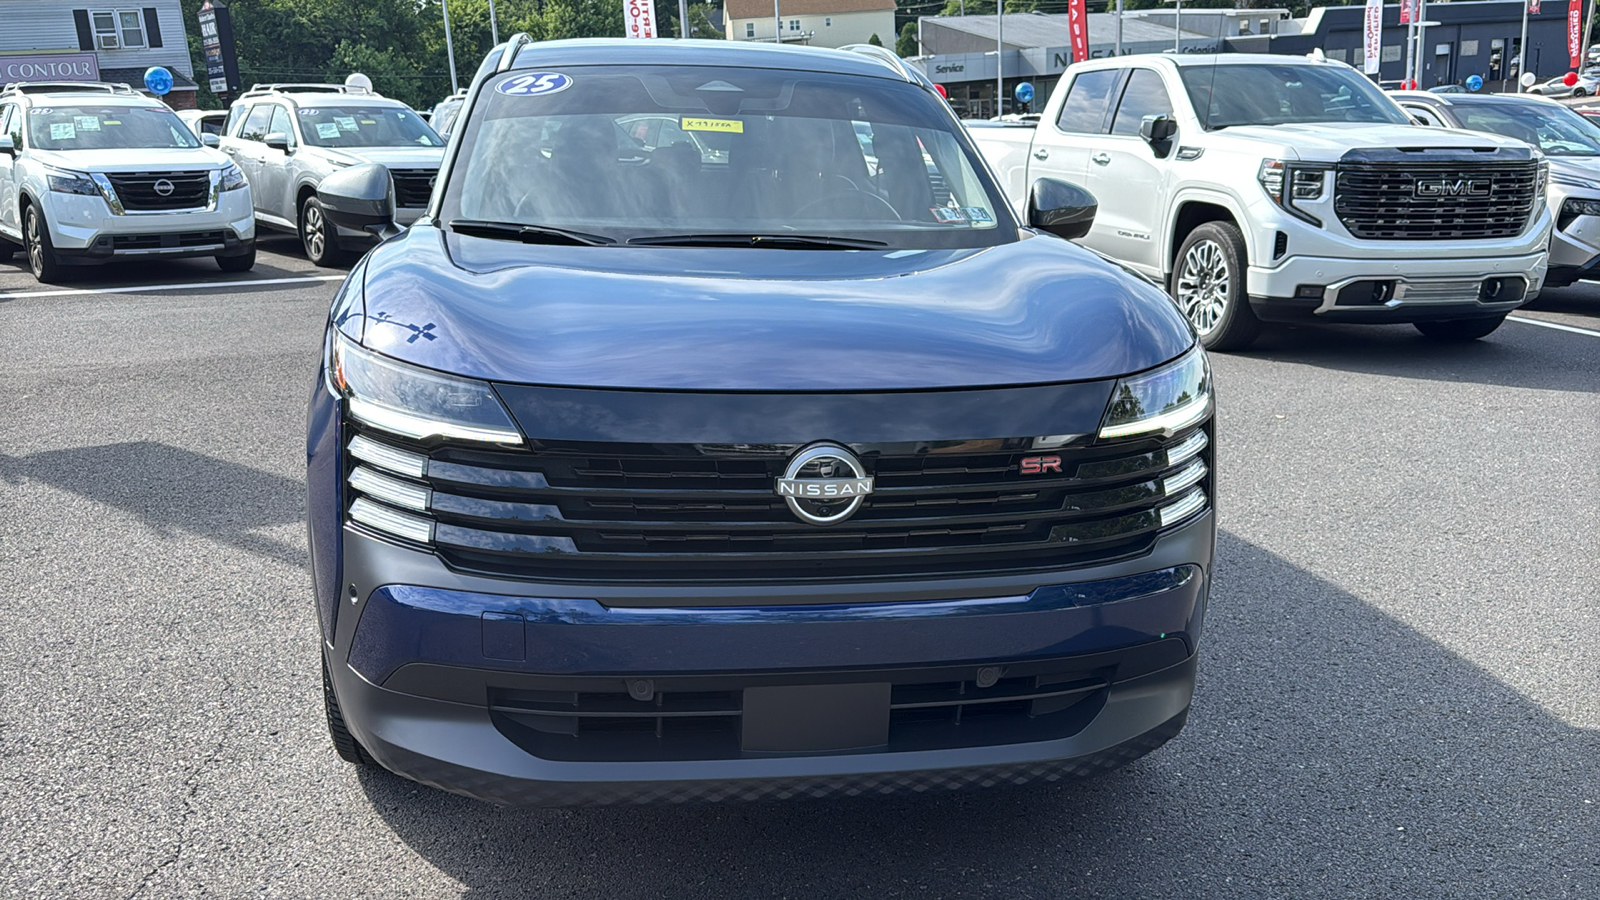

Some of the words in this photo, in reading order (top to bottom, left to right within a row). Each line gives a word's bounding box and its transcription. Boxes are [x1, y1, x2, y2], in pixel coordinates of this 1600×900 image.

[7, 62, 91, 79] CONTOUR
[935, 63, 965, 74] Service
[505, 74, 560, 94] 25
[1417, 179, 1490, 196] GMC
[1021, 456, 1063, 474] SR
[780, 481, 870, 496] NISSAN
